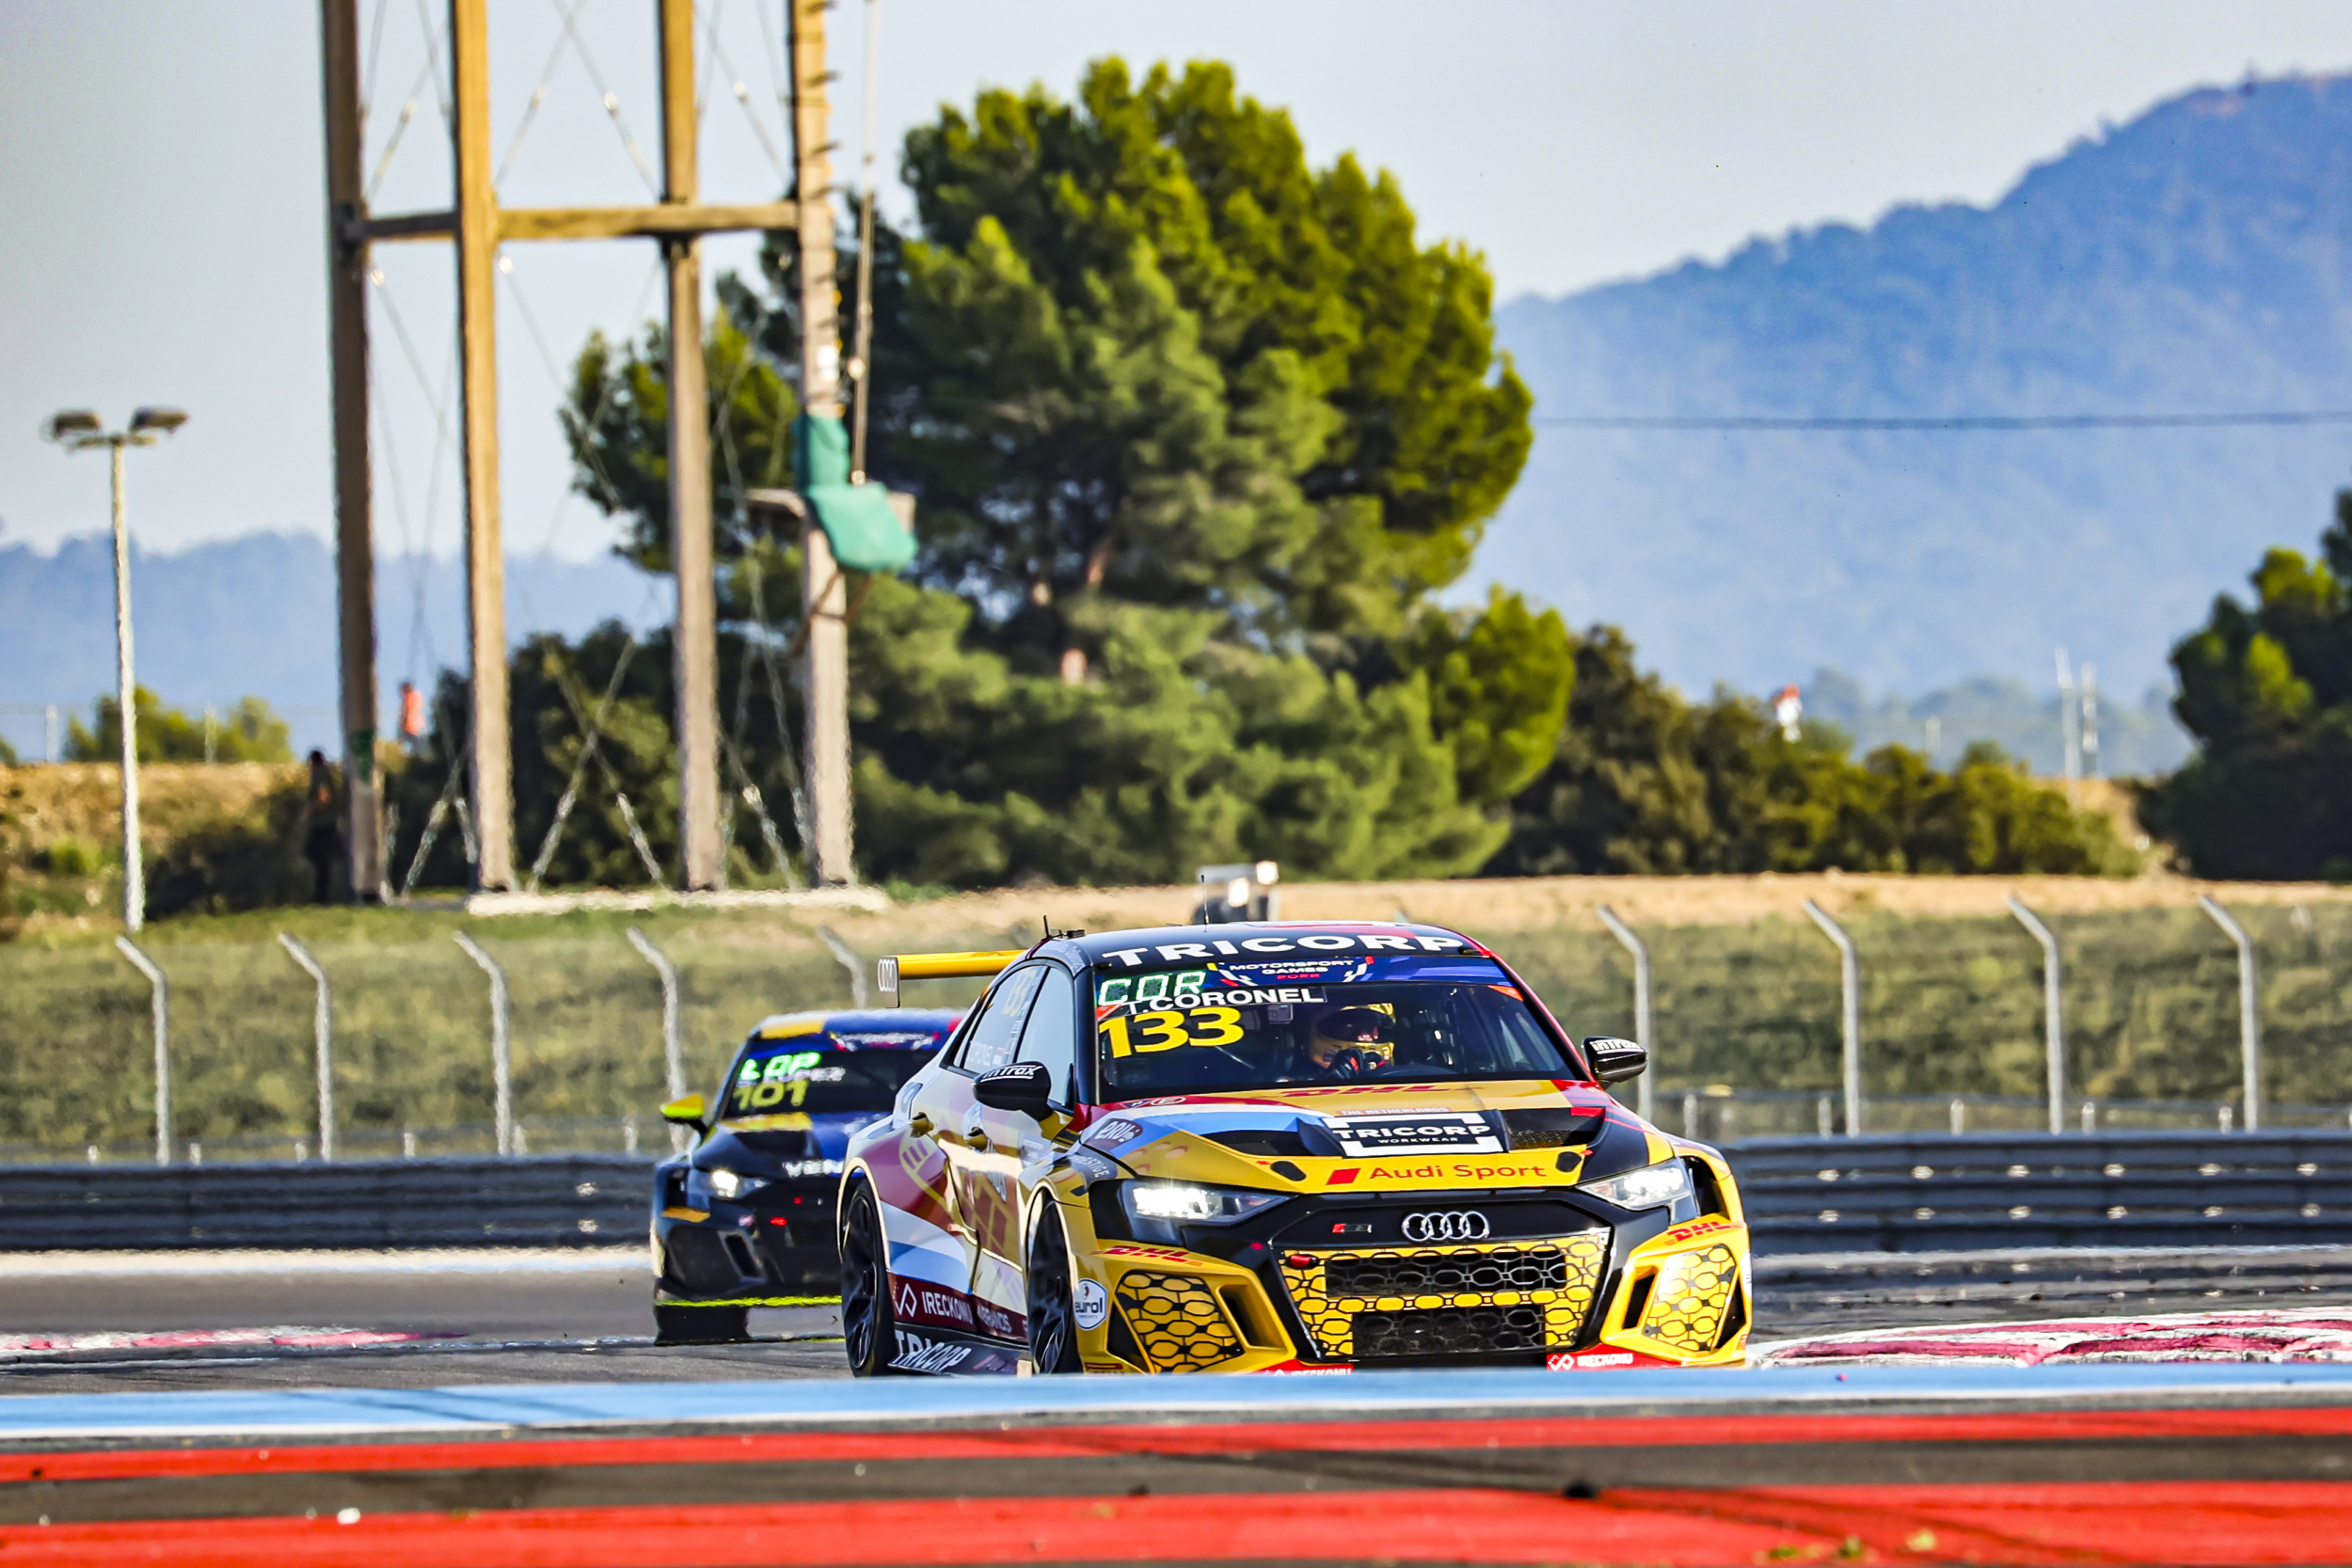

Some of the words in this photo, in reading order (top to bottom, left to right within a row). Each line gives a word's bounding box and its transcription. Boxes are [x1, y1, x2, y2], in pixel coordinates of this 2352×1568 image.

[1102, 935, 1463, 967] TRICORP
[1230, 960, 1354, 971] MOTORSPORT
[1098, 971, 1207, 1006] COR
[1099, 1006, 1244, 1059] 133
[1279, 1085, 1454, 1098] DHL
[1332, 1125, 1491, 1139] TRICORP
[1377, 1136, 1459, 1145] WORKWEAR
[1370, 1164, 1443, 1180] Audi
[1453, 1163, 1548, 1180] Sport
[1667, 1221, 1732, 1242] DHL
[1102, 1244, 1192, 1263] DHL
[1074, 1297, 1104, 1314] eurol
